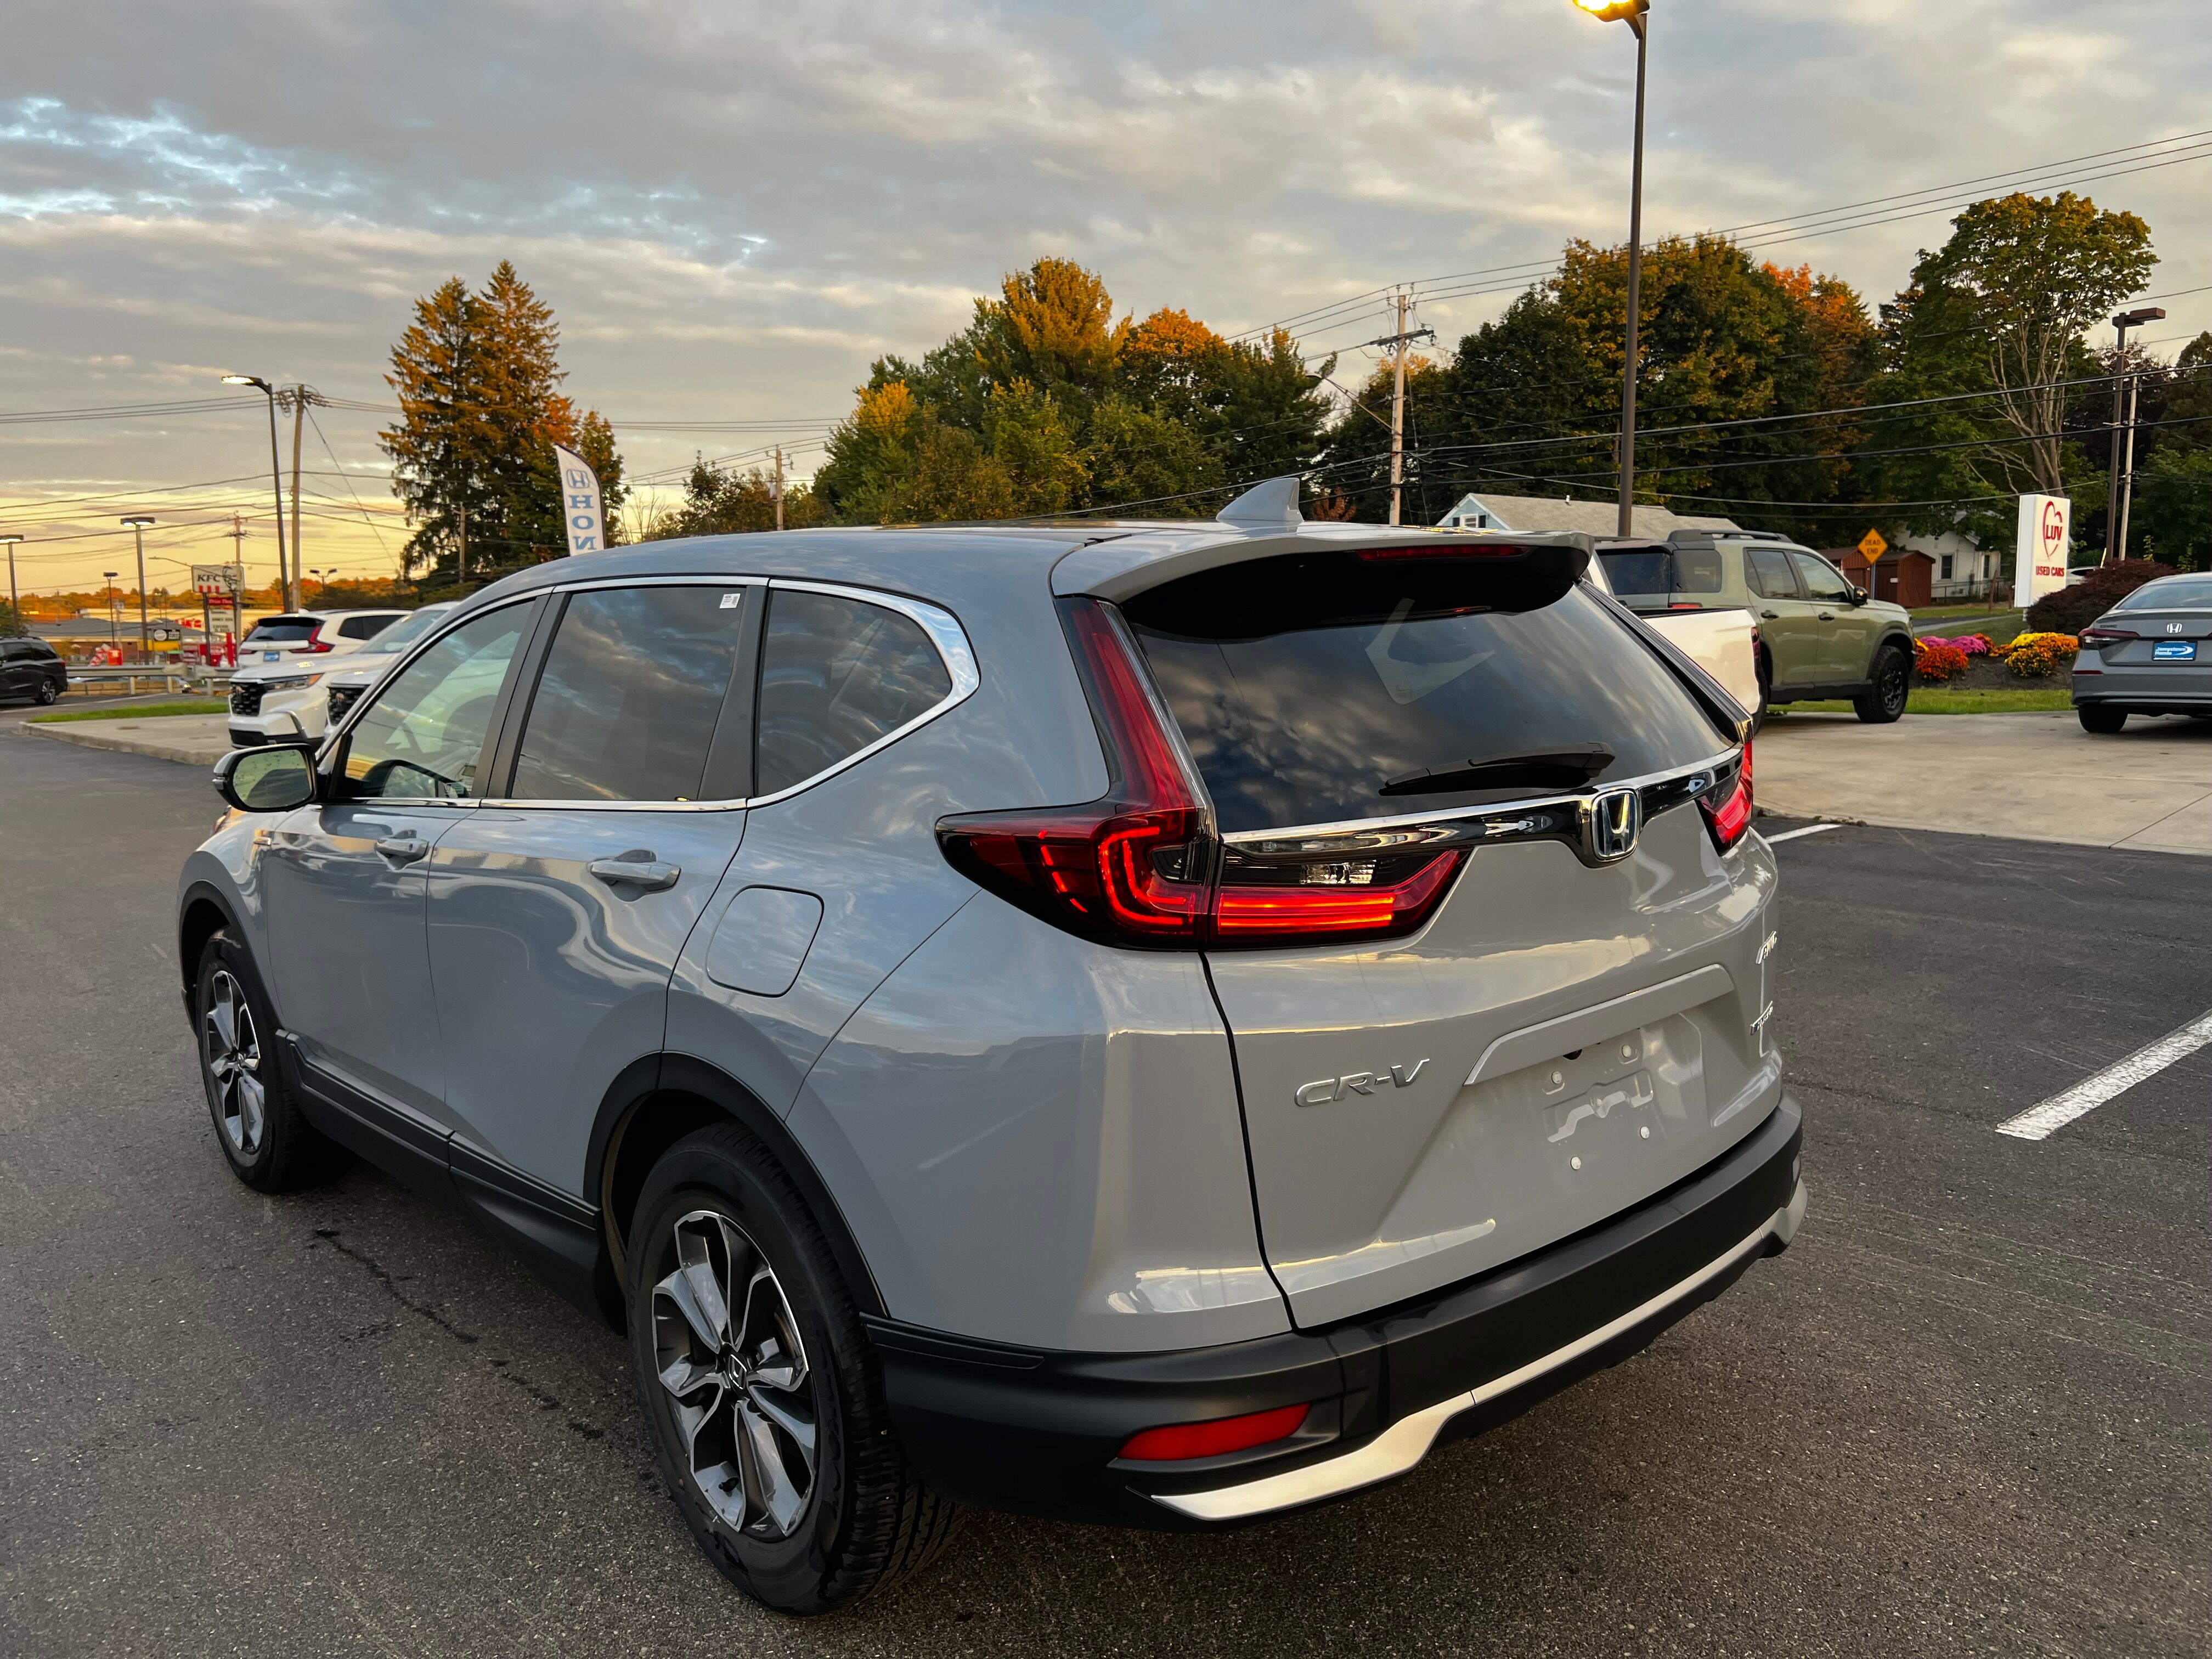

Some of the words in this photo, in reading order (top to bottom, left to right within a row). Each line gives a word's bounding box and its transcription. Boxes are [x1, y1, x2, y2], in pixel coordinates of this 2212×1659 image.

[2045, 524, 2063, 541] LUV
[2036, 566, 2050, 576] USED
[2051, 567, 2065, 577] CARS
[1294, 1058, 1430, 1107] CR-V
